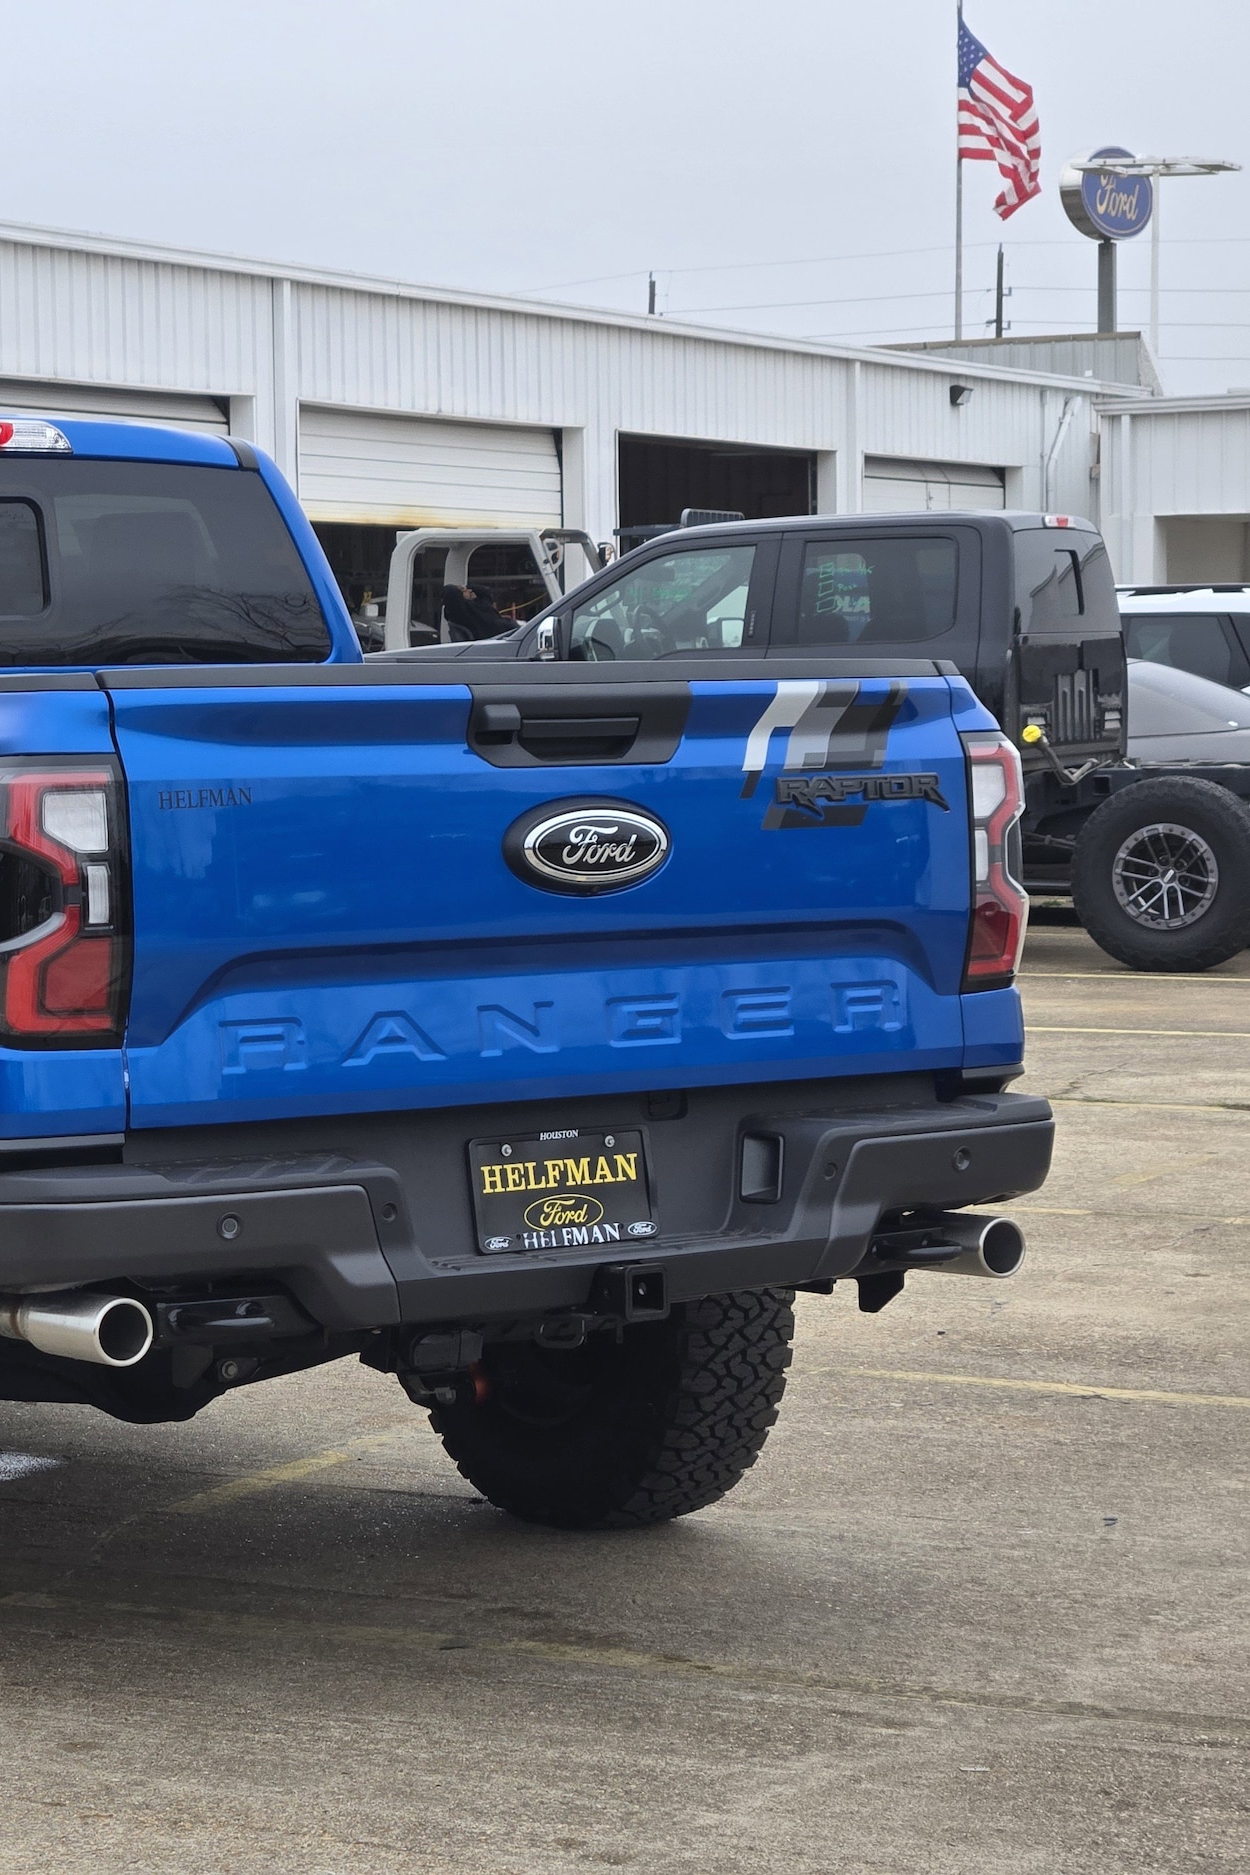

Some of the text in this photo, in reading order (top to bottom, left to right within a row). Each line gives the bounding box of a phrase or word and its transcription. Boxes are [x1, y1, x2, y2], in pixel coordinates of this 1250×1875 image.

[158, 786, 253, 810] HELFMAN
[777, 772, 951, 821] RAPTOR
[562, 825, 638, 865] Ford
[218, 978, 902, 1075] RANGER
[539, 1129, 579, 1141] HOUSTON
[480, 1152, 638, 1194] HELFMAN
[539, 1199, 588, 1227] Ford
